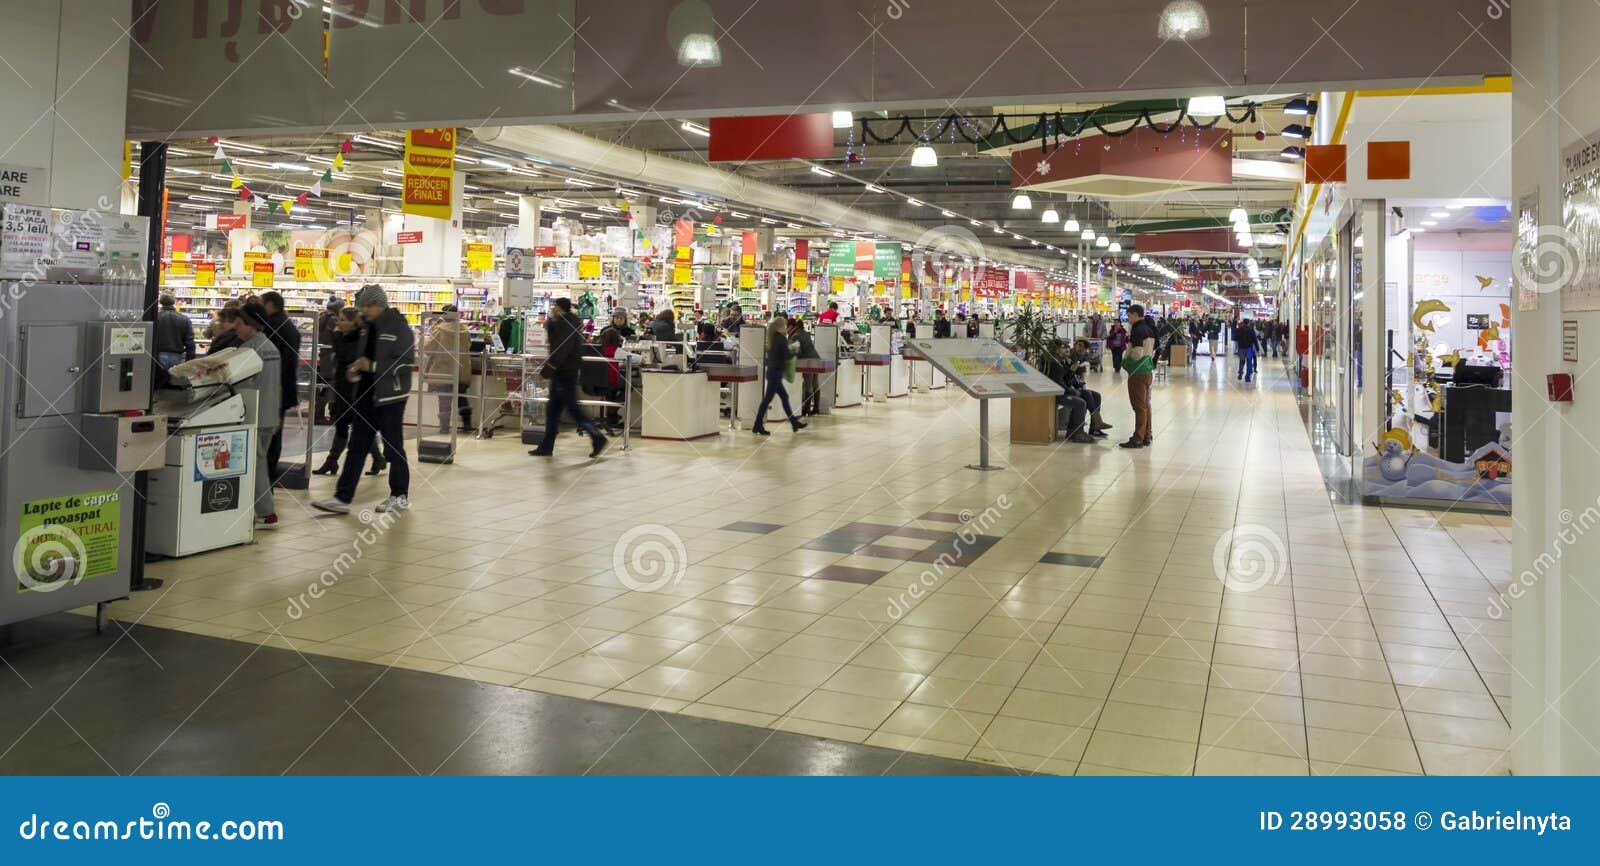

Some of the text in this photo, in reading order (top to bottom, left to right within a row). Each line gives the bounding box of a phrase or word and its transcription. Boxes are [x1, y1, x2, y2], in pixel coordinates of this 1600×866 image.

[1582, 147, 1590, 166] DE
[0, 171, 28, 184] ARE
[408, 178, 448, 190] REDUCERI
[414, 189, 443, 200] FINALE
[23, 216, 47, 224] VACA
[6, 221, 24, 233] 3,5
[24, 501, 61, 515] Lapte
[65, 497, 80, 508] de
[43, 509, 101, 529] proaspat
